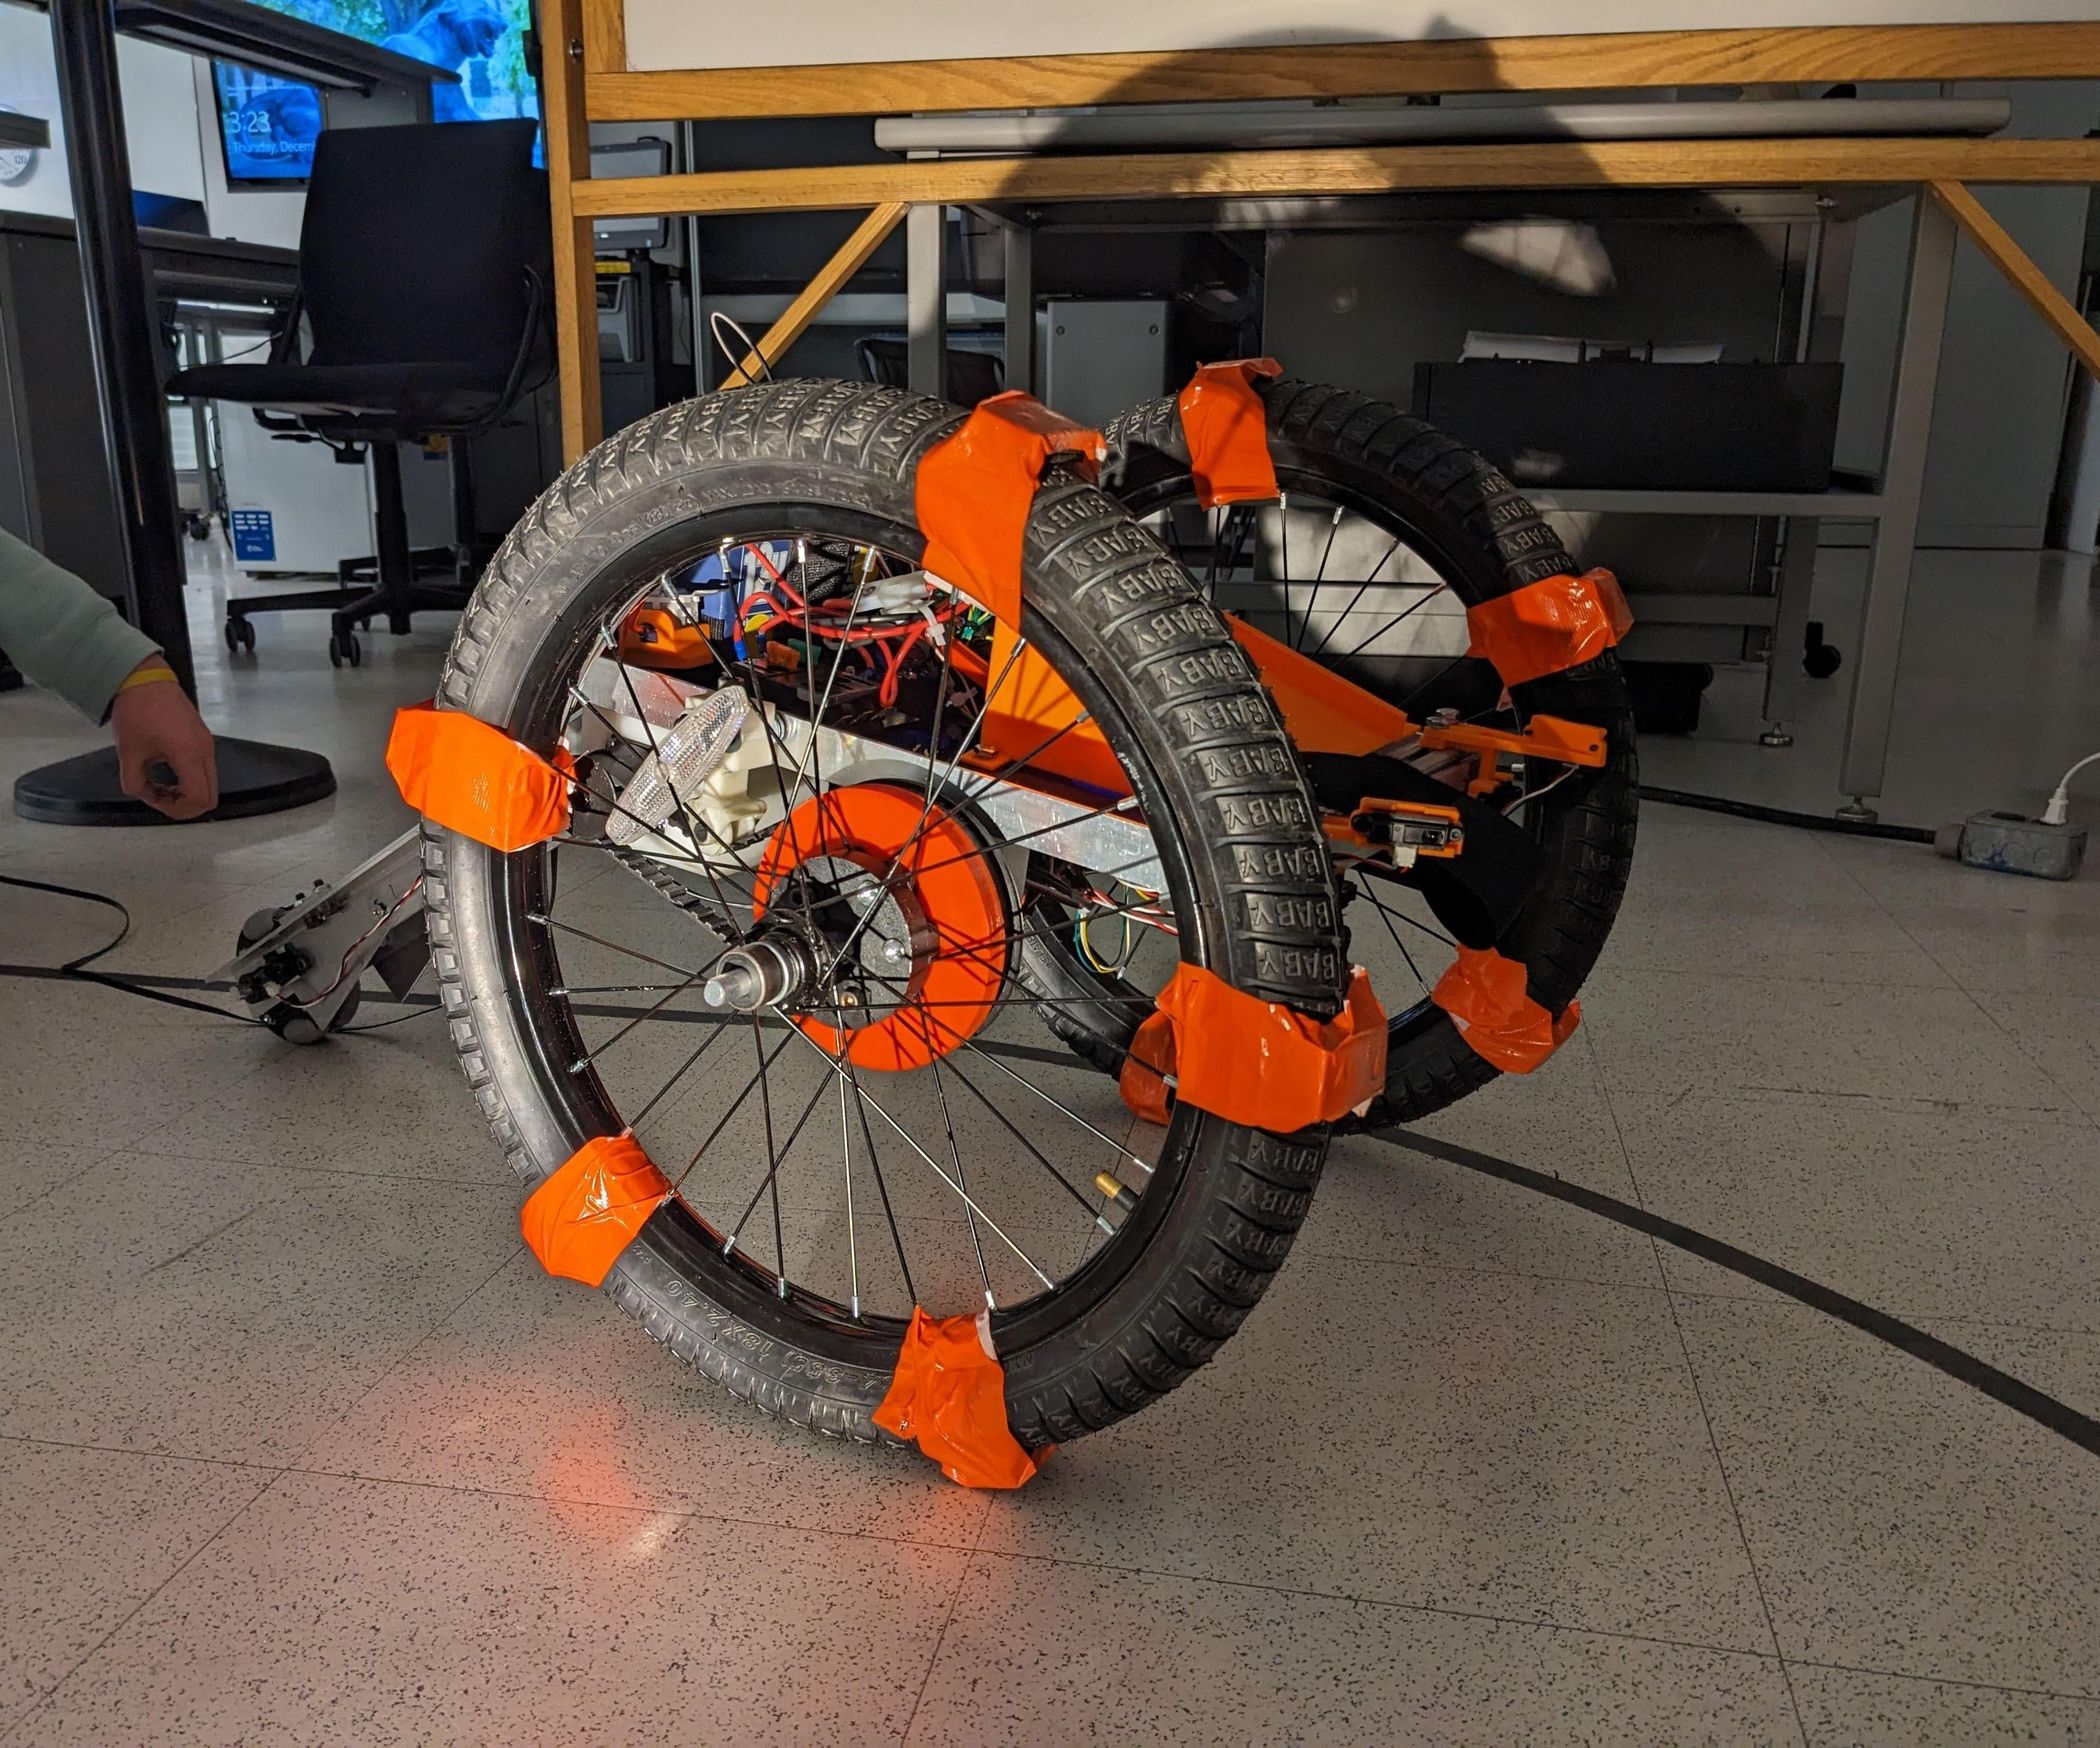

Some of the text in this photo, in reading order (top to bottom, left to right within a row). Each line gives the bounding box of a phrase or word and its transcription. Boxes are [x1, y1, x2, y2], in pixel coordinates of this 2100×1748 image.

[228, 111, 272, 134] 3:23
[1031, 494, 1112, 545] BABY
[1065, 527, 1149, 578] BABY
[1101, 564, 1182, 619] BABY
[1131, 605, 1214, 651] BABY
[1159, 651, 1242, 692] BABY
[1184, 698, 1268, 737] BABY
[1208, 747, 1289, 782] BABY
[1227, 798, 1307, 830] BABY
[1242, 848, 1321, 878] BABY
[1254, 900, 1331, 929] BABY
[1260, 950, 1335, 980] BABY
[1250, 1140, 1320, 1173] BABY
